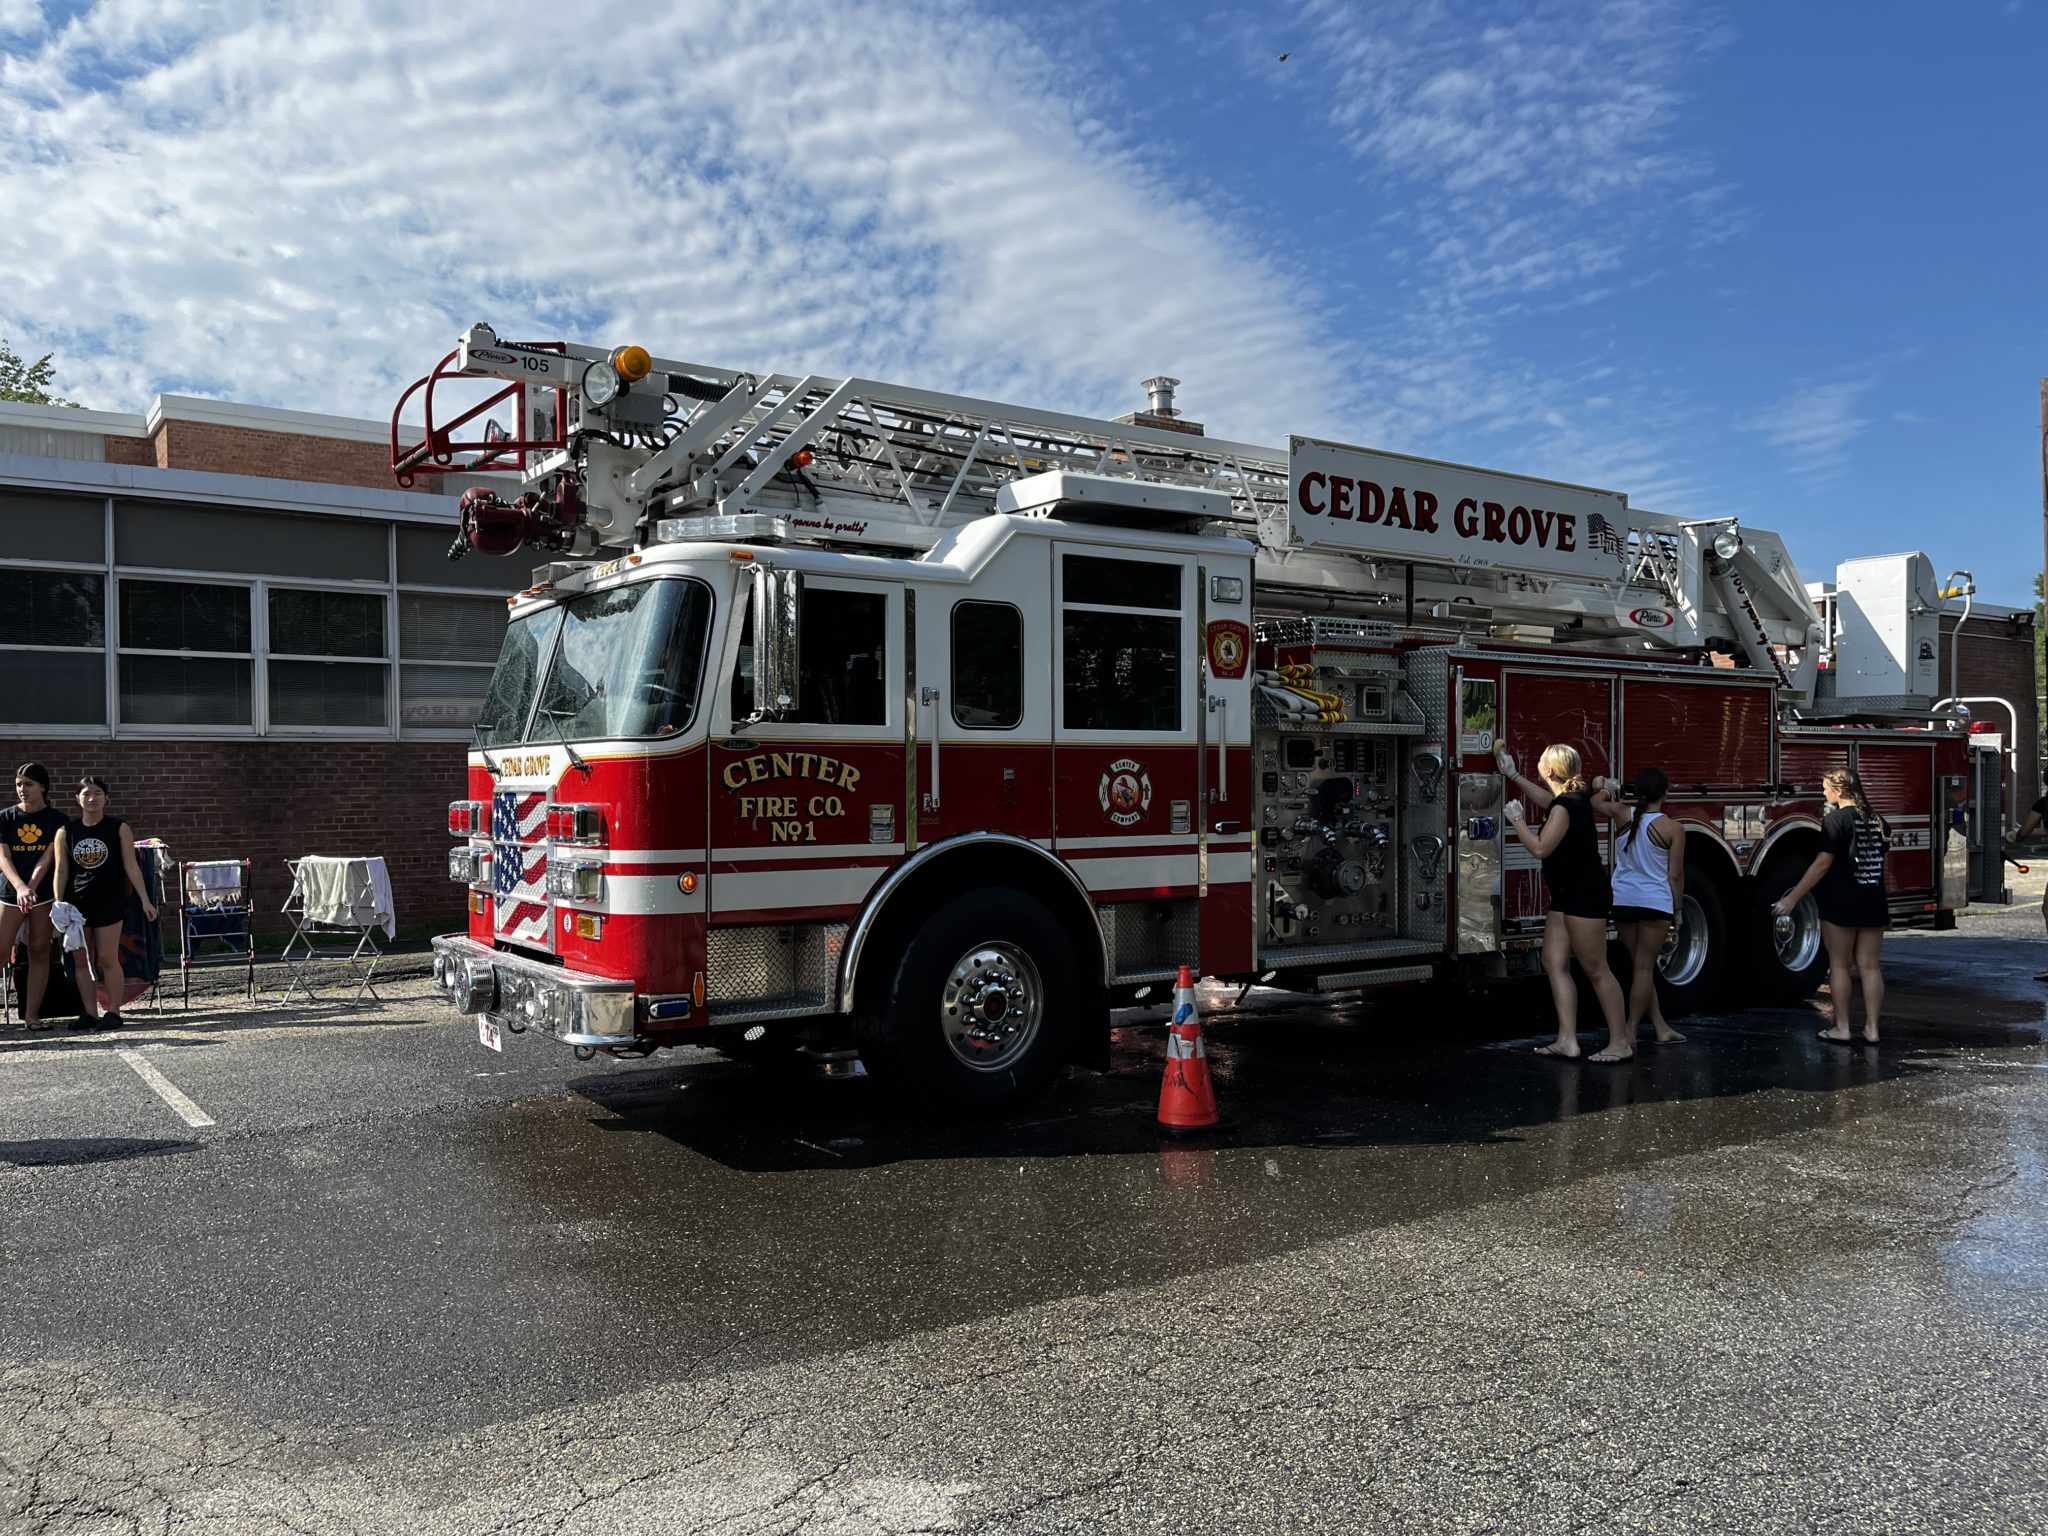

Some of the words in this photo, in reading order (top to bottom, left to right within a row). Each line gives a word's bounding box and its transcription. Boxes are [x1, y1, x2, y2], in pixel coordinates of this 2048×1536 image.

[478, 351, 508, 361] Pierce
[521, 356, 550, 373] 105
[1298, 471, 1439, 534] CEDAR
[1453, 497, 1577, 552] GROVE
[823, 517, 835, 530] be
[1729, 572, 1746, 595] 100
[1639, 609, 1664, 624] Pierce
[524, 754, 551, 776] GROVE
[722, 752, 861, 792] CENTER
[1115, 761, 1135, 769] CENTER
[739, 796, 798, 818] FIRE
[807, 795, 846, 817] CO.
[1112, 813, 1138, 823] COMPANY
[1909, 832, 1919, 846] 74
[80, 846, 100, 854] 2023
[485, 1023, 495, 1047] 74
